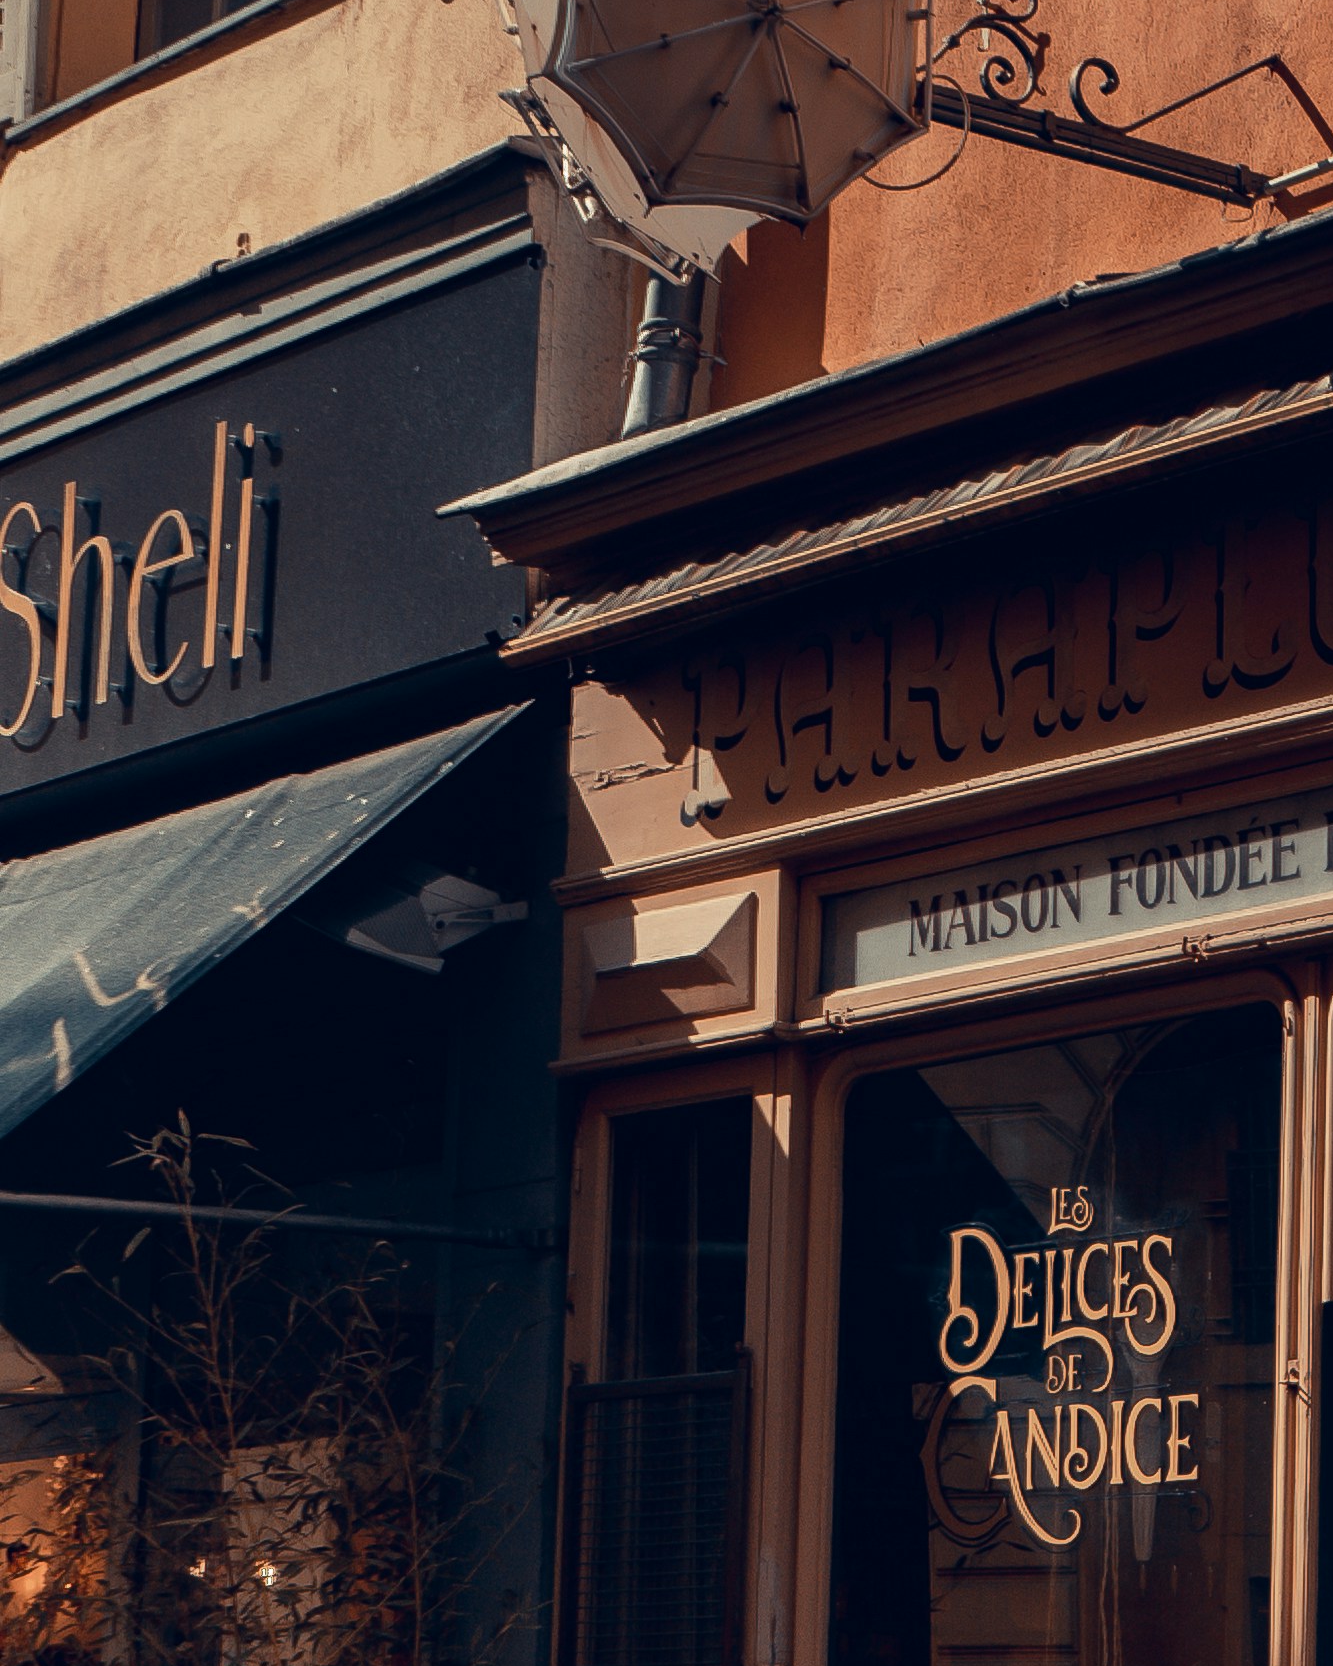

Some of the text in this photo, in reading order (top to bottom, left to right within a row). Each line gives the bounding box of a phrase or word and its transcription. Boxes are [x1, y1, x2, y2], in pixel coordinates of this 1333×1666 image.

[907, 863, 1083, 958] MAISON
[1107, 817, 1301, 917] FONDÉE
[1047, 1185, 1094, 1236] LES
[939, 1227, 1177, 1393] DELICES
[1046, 1354, 1083, 1395] DE
[918, 1375, 1200, 1546] CANDICE
